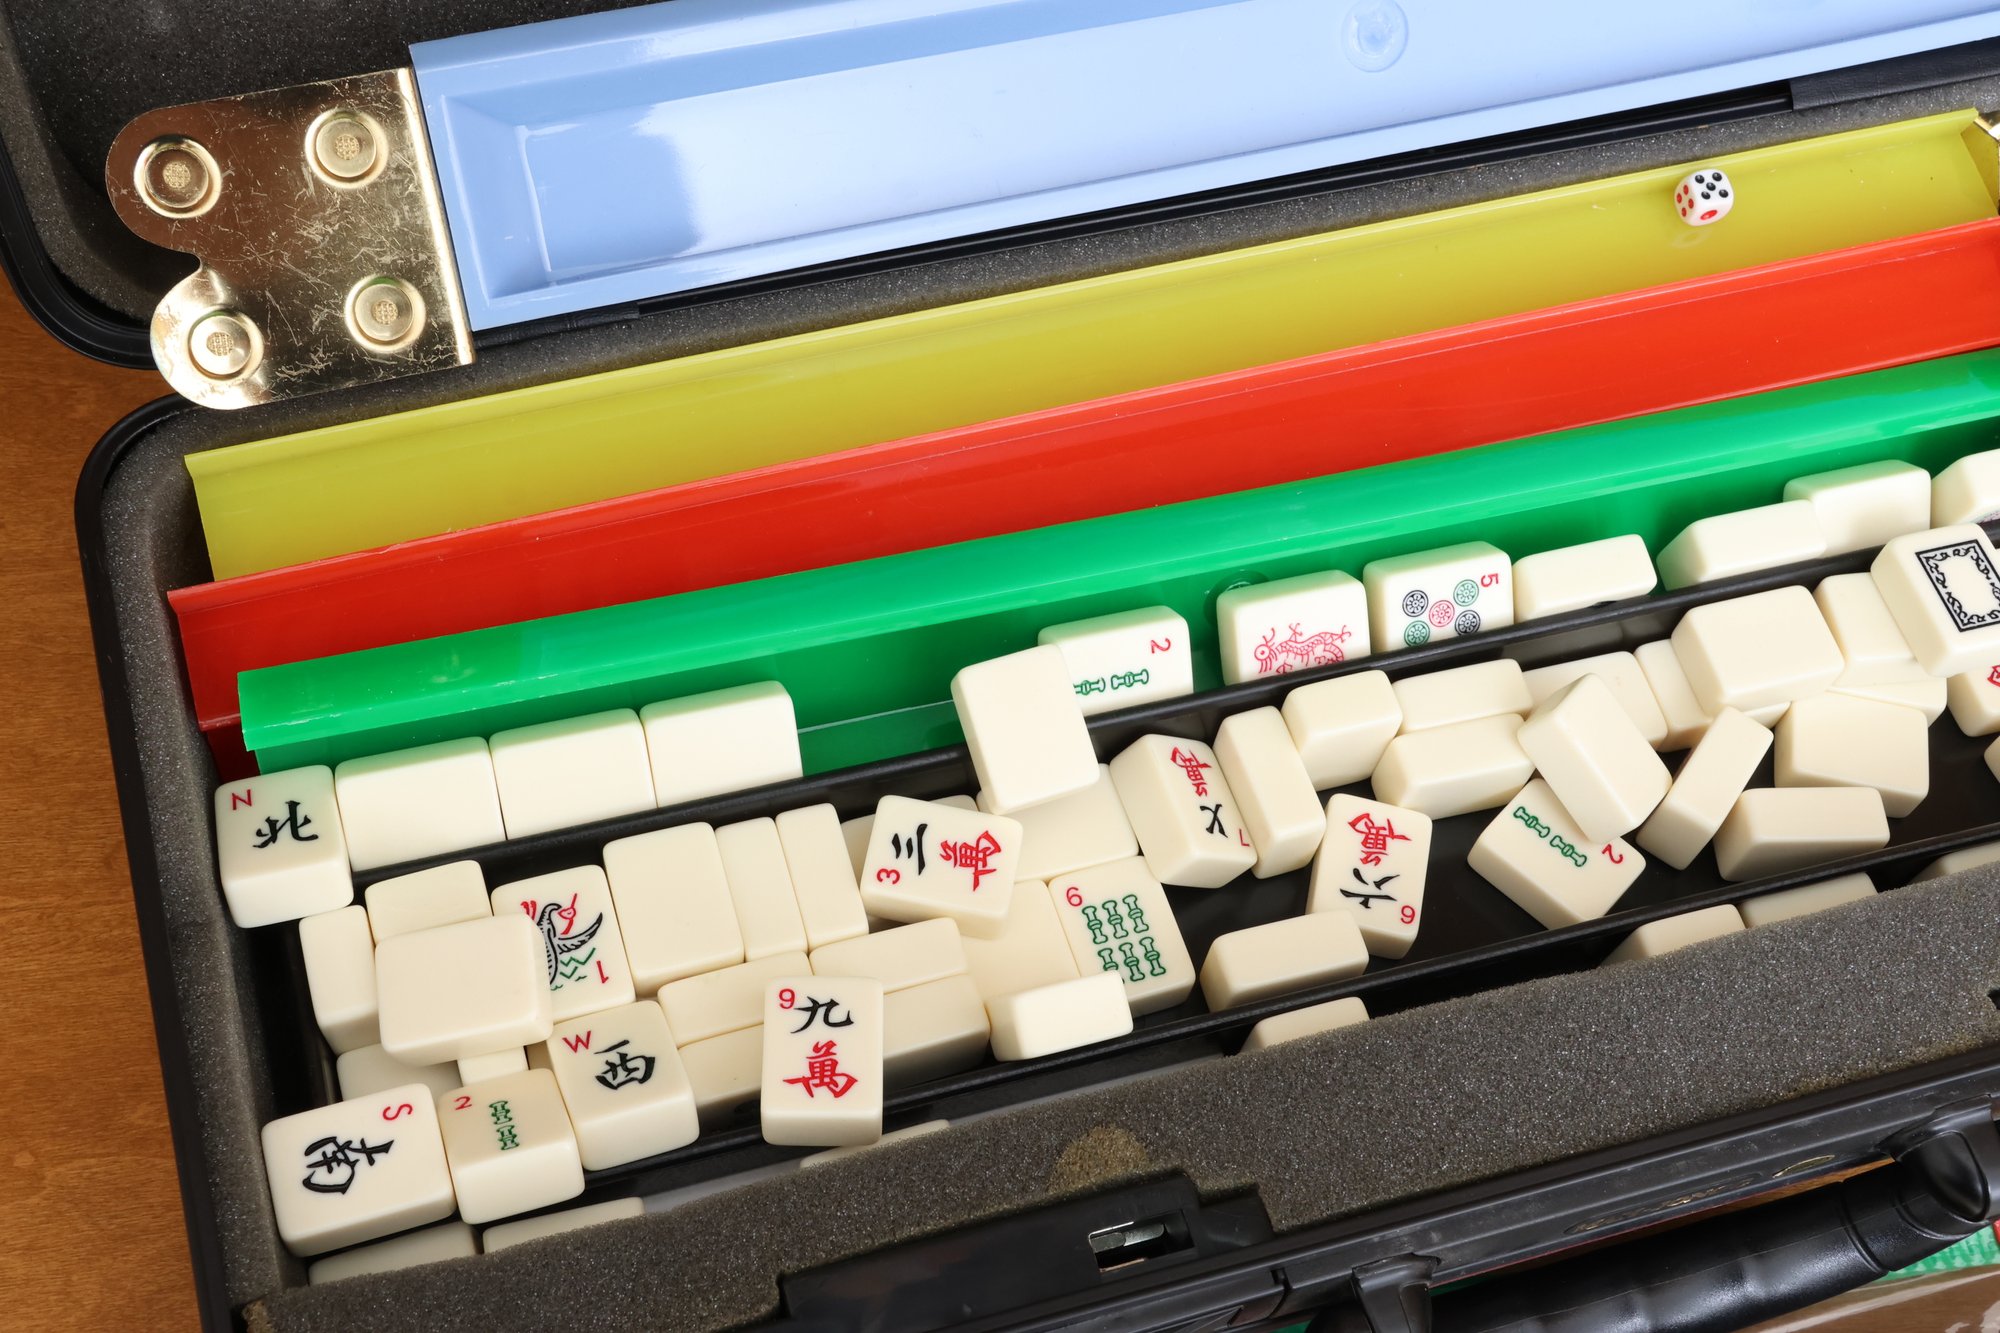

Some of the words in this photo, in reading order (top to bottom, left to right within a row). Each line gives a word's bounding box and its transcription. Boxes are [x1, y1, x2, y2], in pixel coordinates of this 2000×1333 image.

[1480, 573, 1500, 588] 5
[1150, 638, 1172, 655] 2
[230, 789, 253, 811] N
[253, 801, 319, 849] 北
[1601, 843, 1625, 865] 2
[875, 867, 902, 886] 3
[1064, 886, 1084, 908] 6
[1399, 904, 1417, 925] 6
[595, 959, 609, 985] 1
[777, 987, 797, 1011] 9
[562, 1030, 592, 1054] W
[594, 1039, 656, 1091] 西
[380, 1102, 415, 1122] S
[453, 1094, 472, 1111] 2
[301, 1136, 394, 1195] 南
